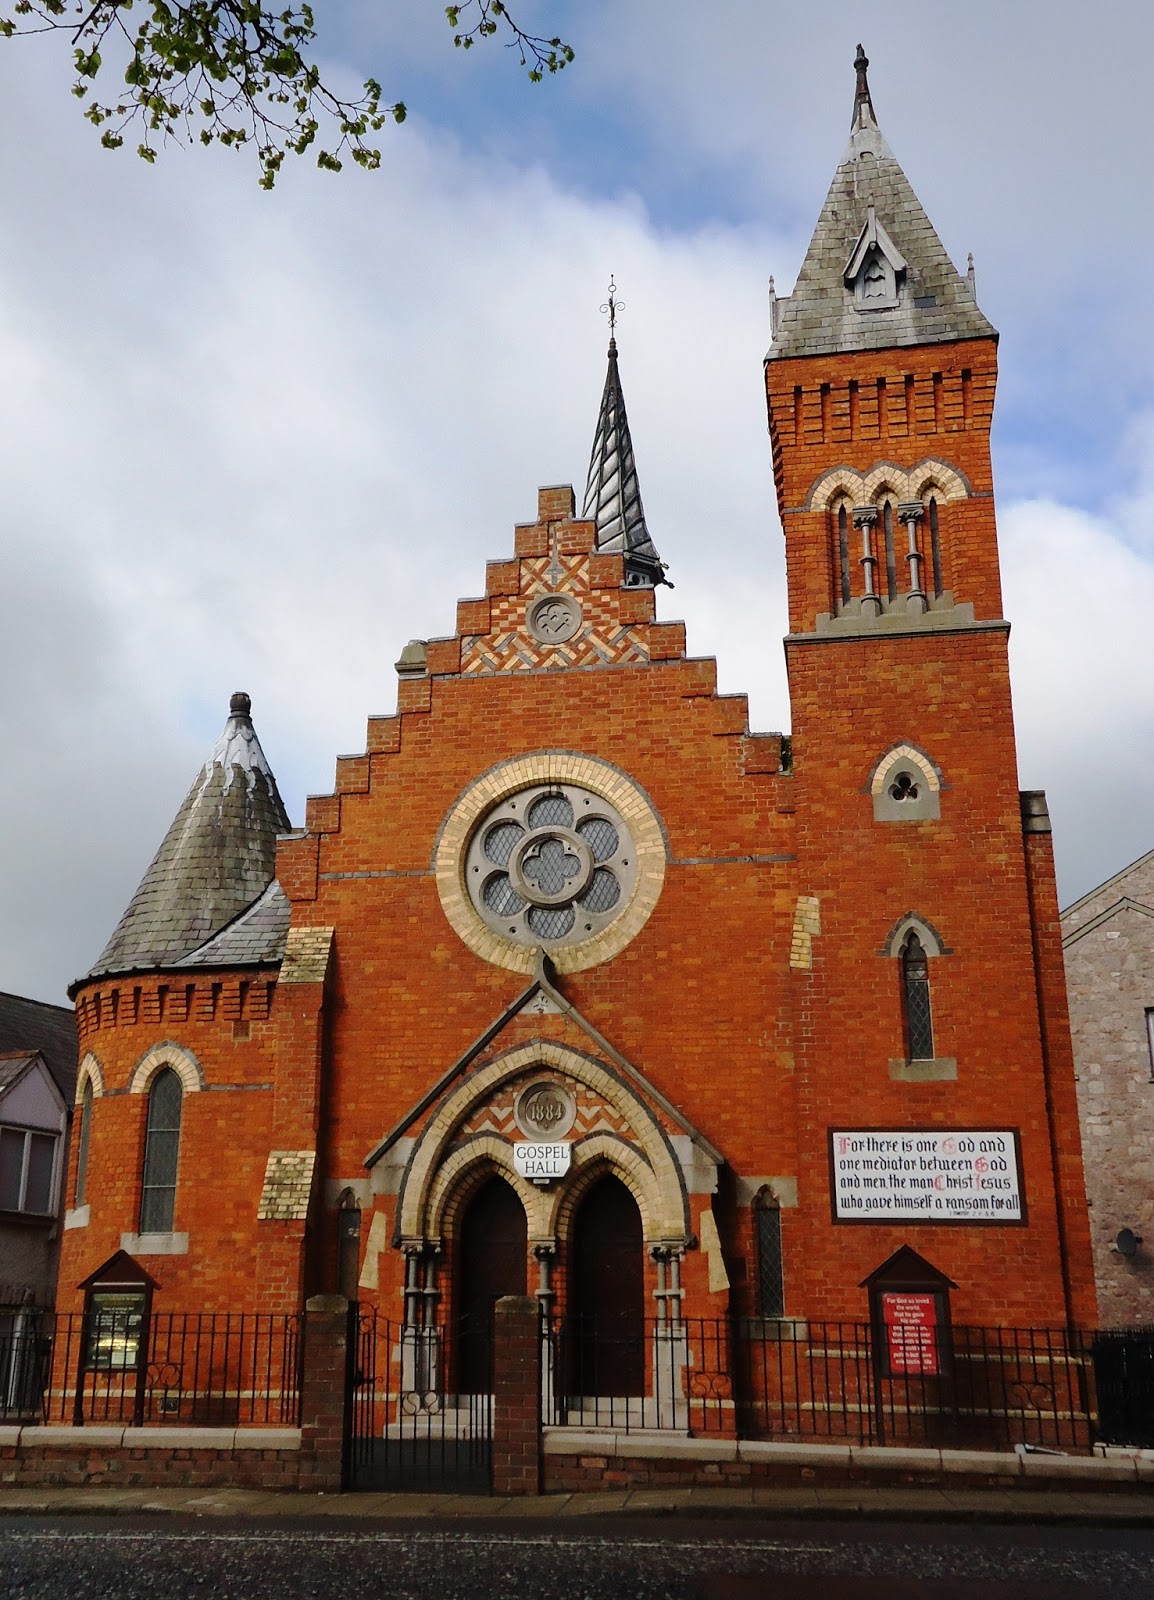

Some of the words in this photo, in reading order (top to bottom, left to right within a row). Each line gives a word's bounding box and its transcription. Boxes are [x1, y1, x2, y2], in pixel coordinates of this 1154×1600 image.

[531, 1103, 563, 1121] 1884
[516, 1146, 568, 1159] GOSPEL
[838, 1136, 865, 1155] For
[866, 1137, 898, 1153] there
[901, 1137, 914, 1153] is
[916, 1140, 938, 1153] one
[942, 1136, 975, 1155] God
[979, 1136, 1006, 1153] and
[525, 1161, 560, 1174] HALL
[839, 1159, 861, 1171] one
[862, 1155, 917, 1171] mediator
[919, 1155, 973, 1171] between
[975, 1155, 1008, 1173] God
[840, 1173, 861, 1189] and
[888, 1174, 907, 1189] the
[909, 1177, 934, 1189] man
[934, 1173, 974, 1191] Christ
[974, 1173, 1012, 1190] Jesus
[840, 1194, 863, 1209] who
[864, 1197, 893, 1212] gave
[893, 1193, 933, 1210] himself
[935, 1198, 943, 1209] a
[945, 1197, 990, 1210] ransom
[990, 1194, 1005, 1210] for
[1005, 1194, 1019, 1210] all
